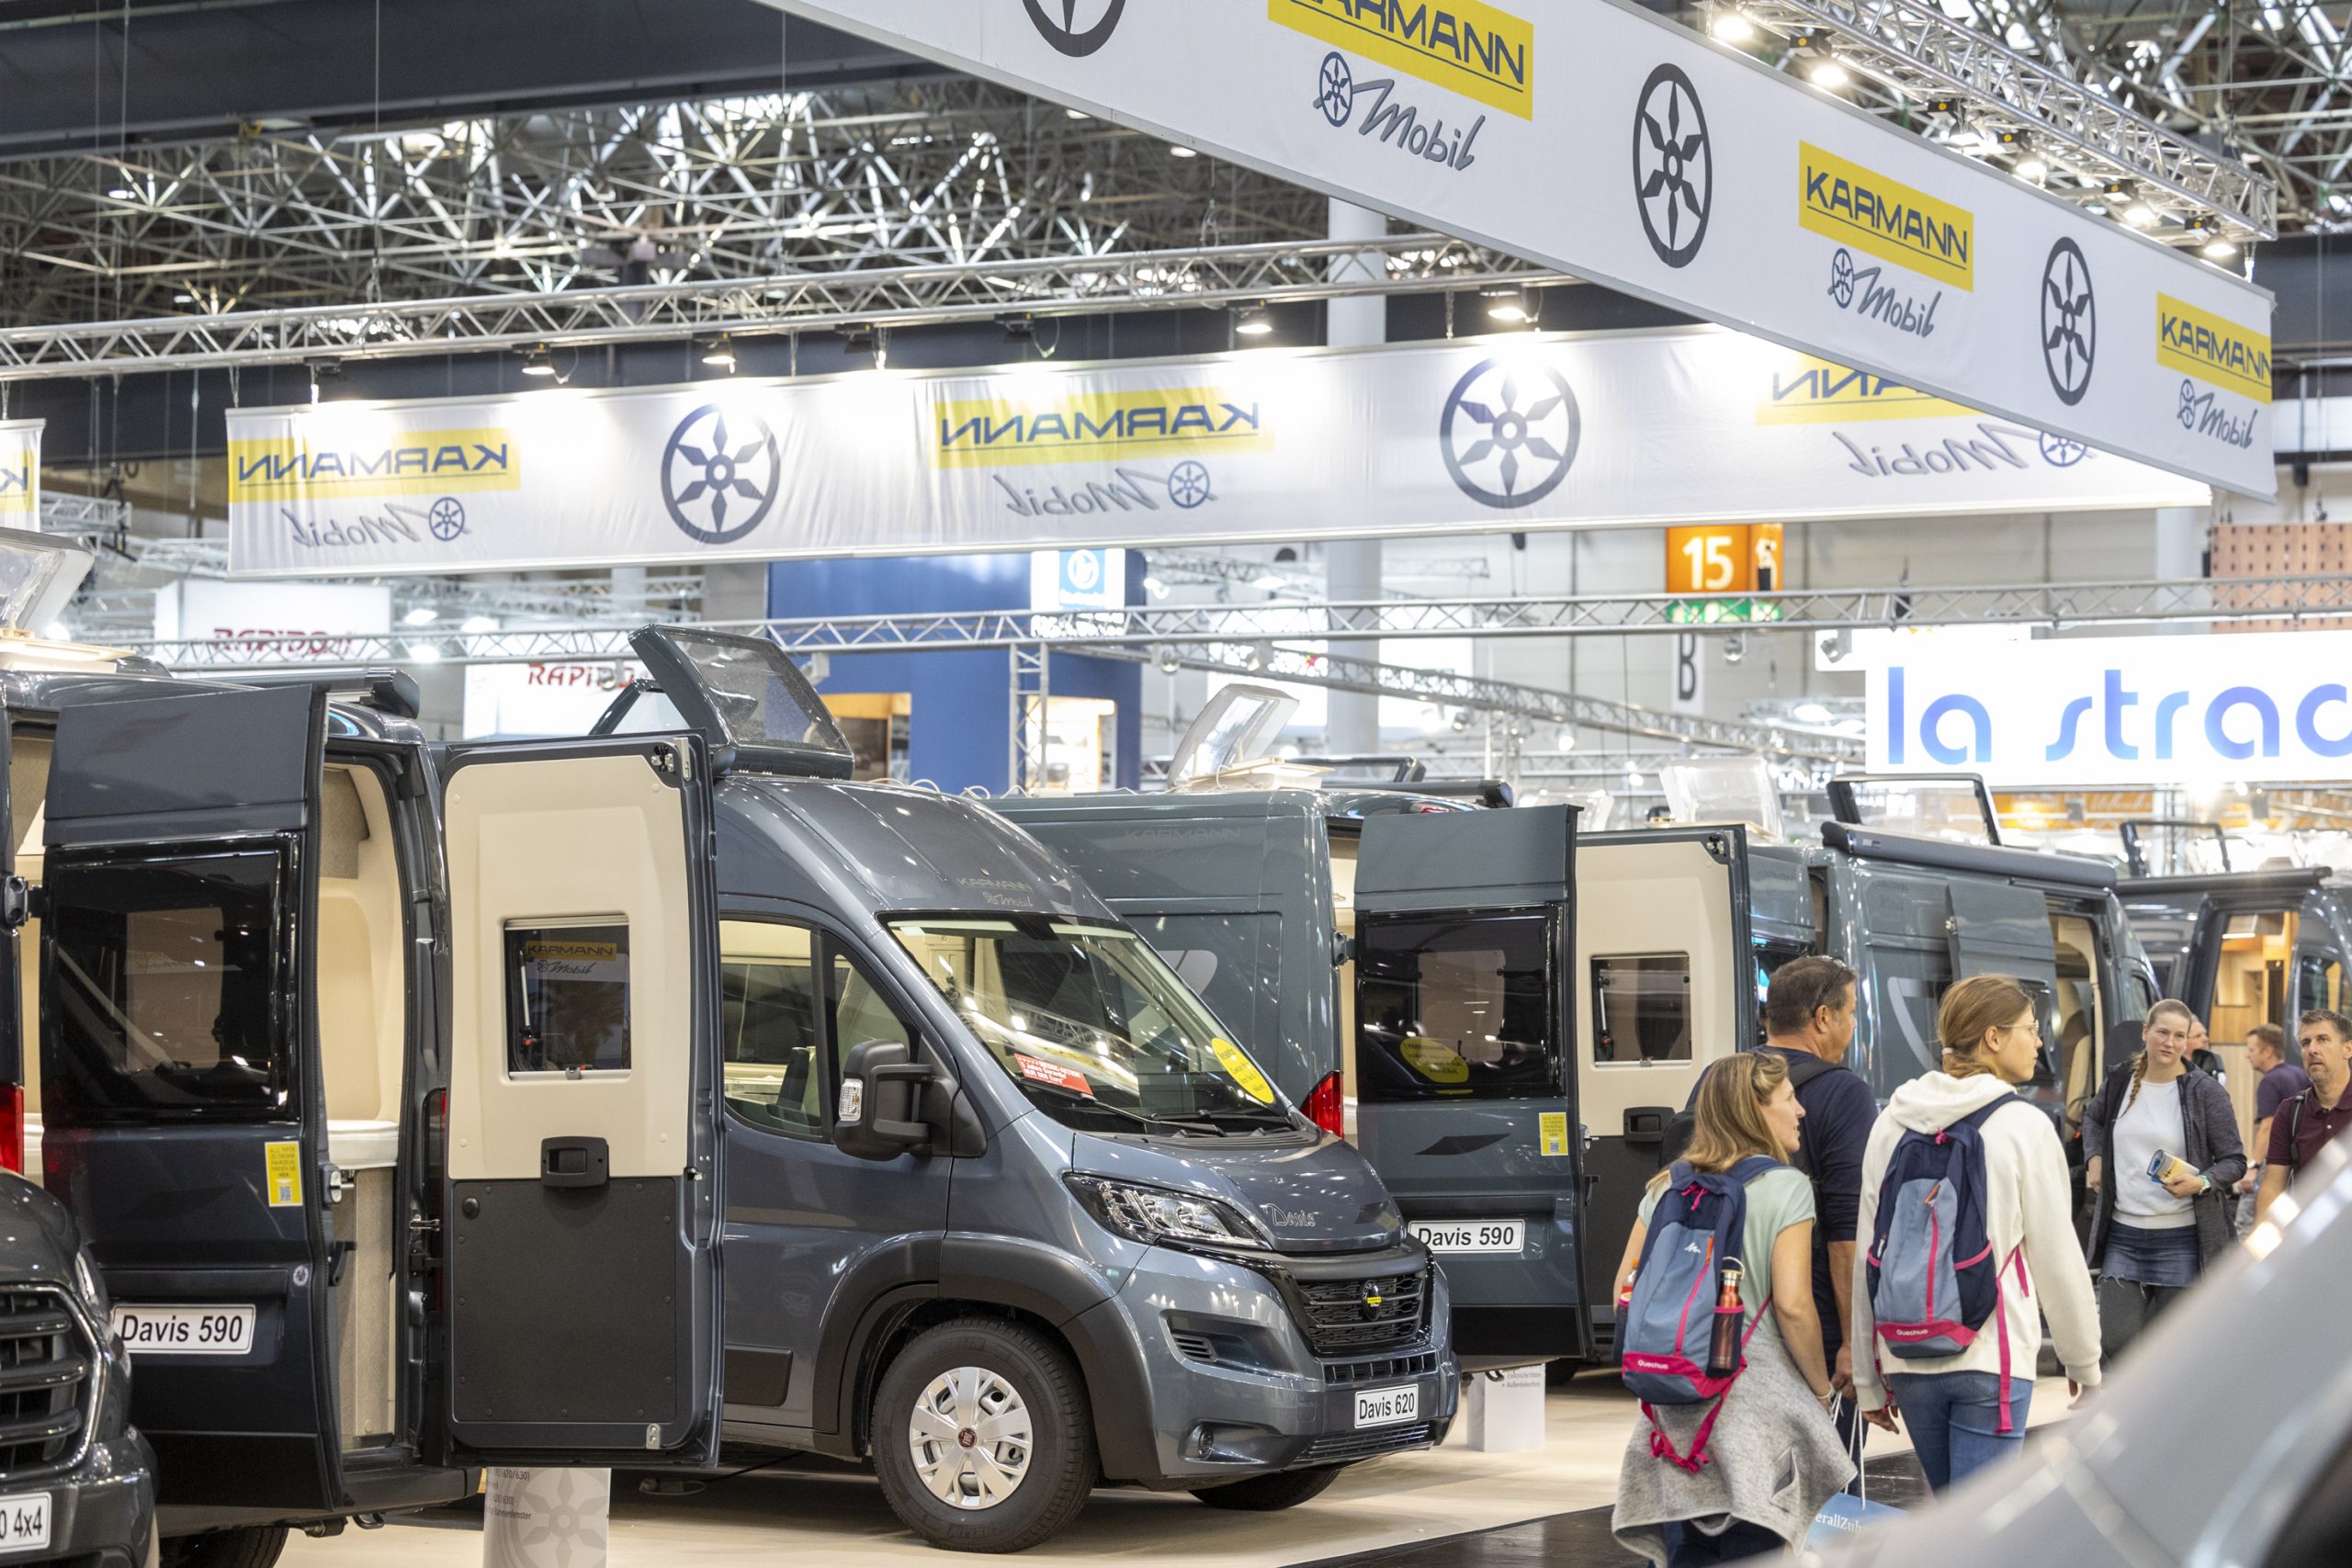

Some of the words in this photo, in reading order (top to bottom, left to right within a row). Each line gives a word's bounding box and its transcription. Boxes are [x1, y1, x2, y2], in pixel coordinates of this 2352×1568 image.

[1314, 0, 1524, 85] RMANN
[1352, 79, 1486, 172] Mobil
[1807, 165, 1967, 265] KARMANN
[1853, 266, 1942, 339] Mobil
[2162, 312, 2272, 380] KARMANN
[2195, 392, 2258, 449] Mobil
[1681, 536, 1735, 591] 15
[1679, 633, 1697, 701] B
[1887, 666, 1992, 765] la
[526, 945, 614, 956] KARMANN
[548, 961, 596, 975] Mobil
[1260, 1203, 1316, 1226] Davis
[1418, 1227, 1472, 1247] Davis
[1478, 1226, 1514, 1246] 590
[121, 1314, 189, 1342] Davis
[198, 1315, 243, 1342] 590
[1360, 1396, 1391, 1420] Davis
[1396, 1393, 1415, 1415] 620
[14, 1506, 42, 1538] 4x4
